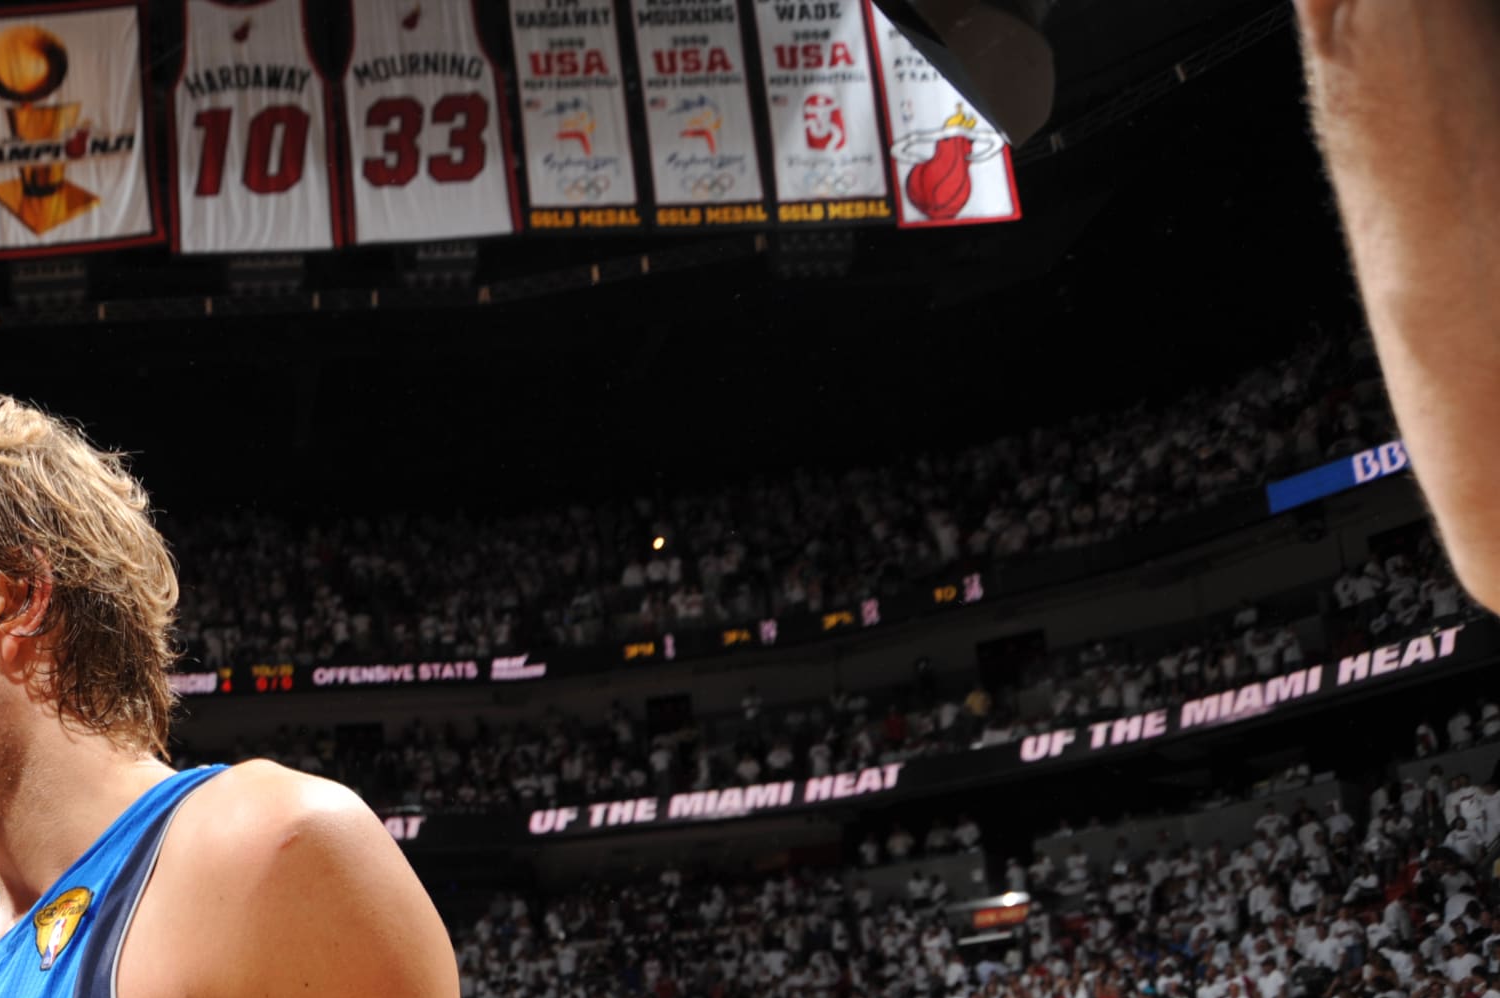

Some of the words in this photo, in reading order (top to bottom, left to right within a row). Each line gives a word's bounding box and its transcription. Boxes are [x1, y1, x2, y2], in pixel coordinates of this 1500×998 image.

[774, 3, 841, 22] WADE
[354, 52, 485, 87] MOURNING
[528, 50, 610, 78] USA
[652, 47, 733, 76] USA
[774, 42, 854, 71] USA
[185, 63, 311, 98] HARDAWAY
[194, 104, 311, 197] 10
[362, 91, 489, 187] 33
[778, 203, 825, 222] GOLD
[828, 200, 891, 219] MEDAL
[1352, 440, 1408, 484] BB
[313, 665, 414, 687] OFFENSIVE
[419, 661, 479, 681] STATS
[1088, 708, 1168, 750] THE
[1180, 665, 1322, 729] MIAMI
[1337, 623, 1466, 686] HEAT
[589, 797, 658, 828] THE
[668, 780, 795, 820] MIAMI
[804, 762, 905, 803] HEAT
